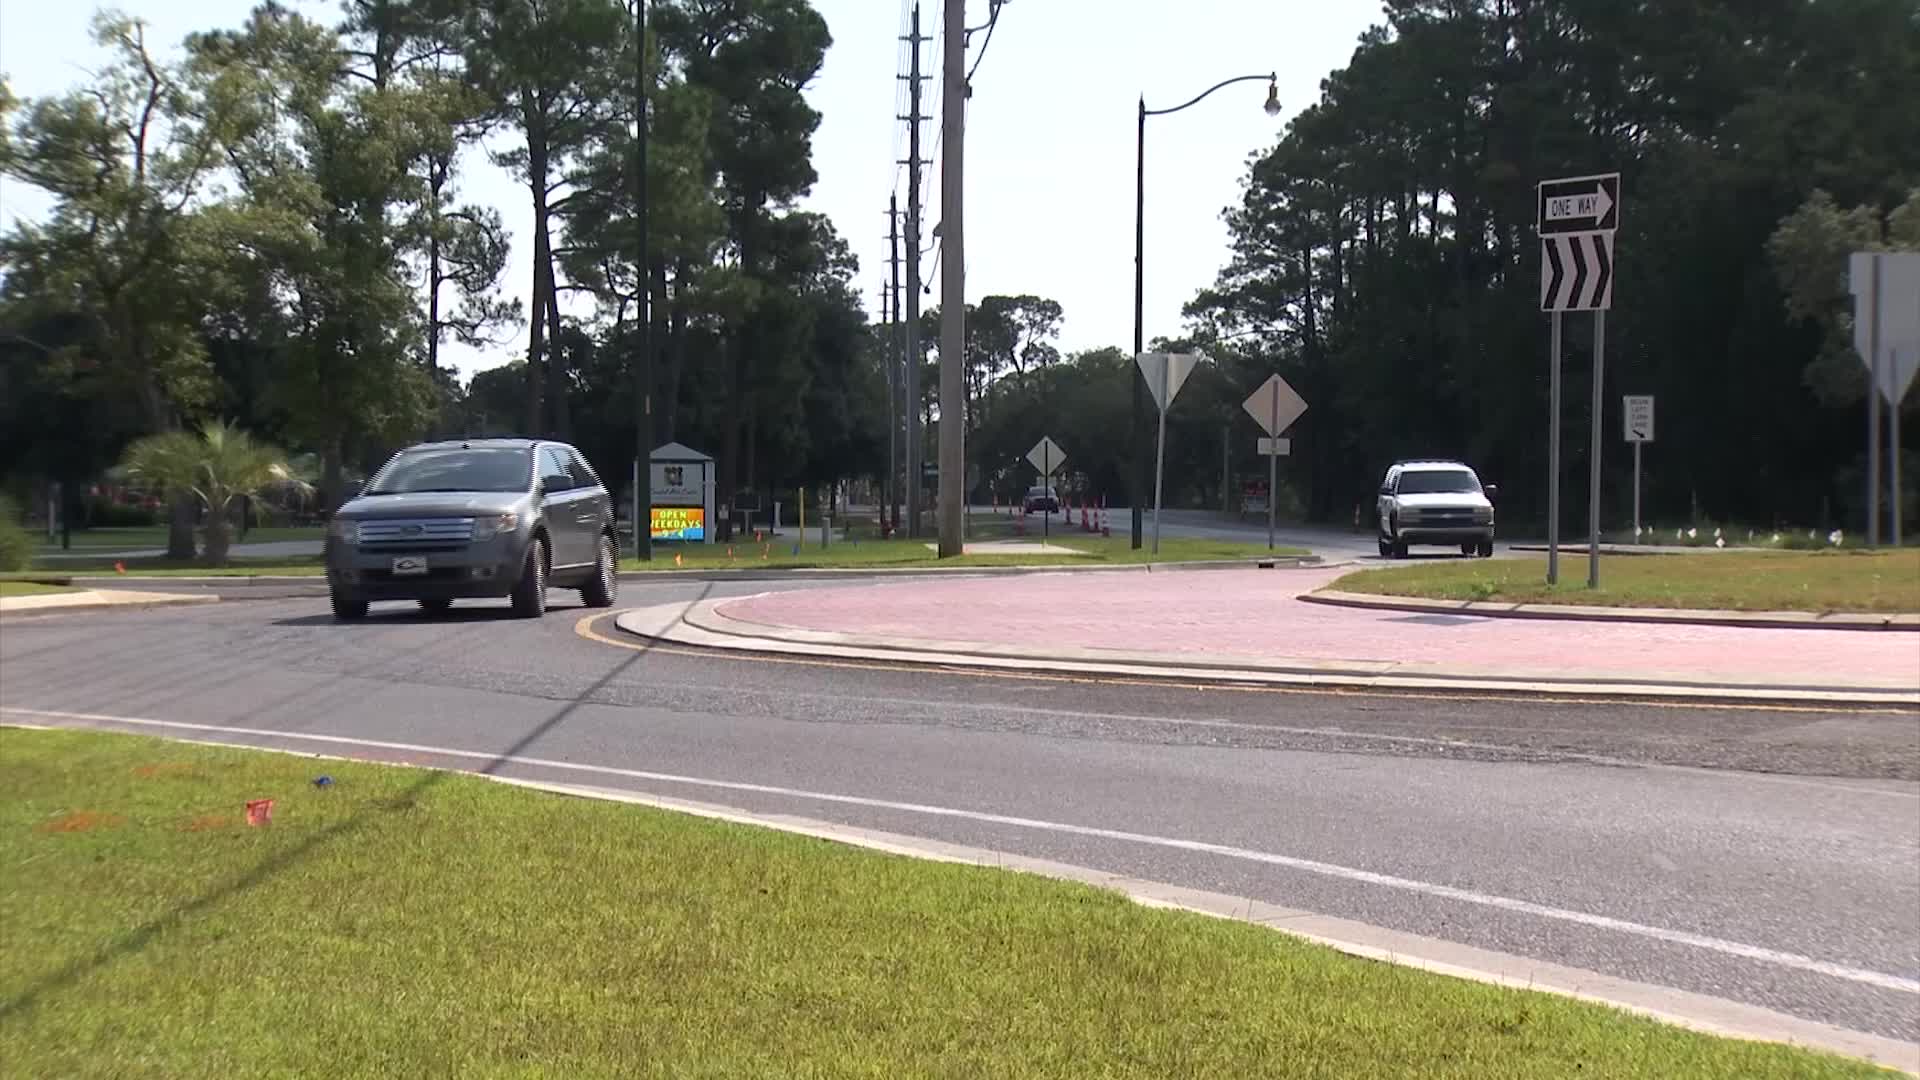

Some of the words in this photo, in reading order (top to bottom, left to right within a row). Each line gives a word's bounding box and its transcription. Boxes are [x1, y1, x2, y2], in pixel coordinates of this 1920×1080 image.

[1552, 199, 1571, 216] ONE
[1578, 196, 1598, 214] WAY
[659, 510, 687, 519] OPEN
